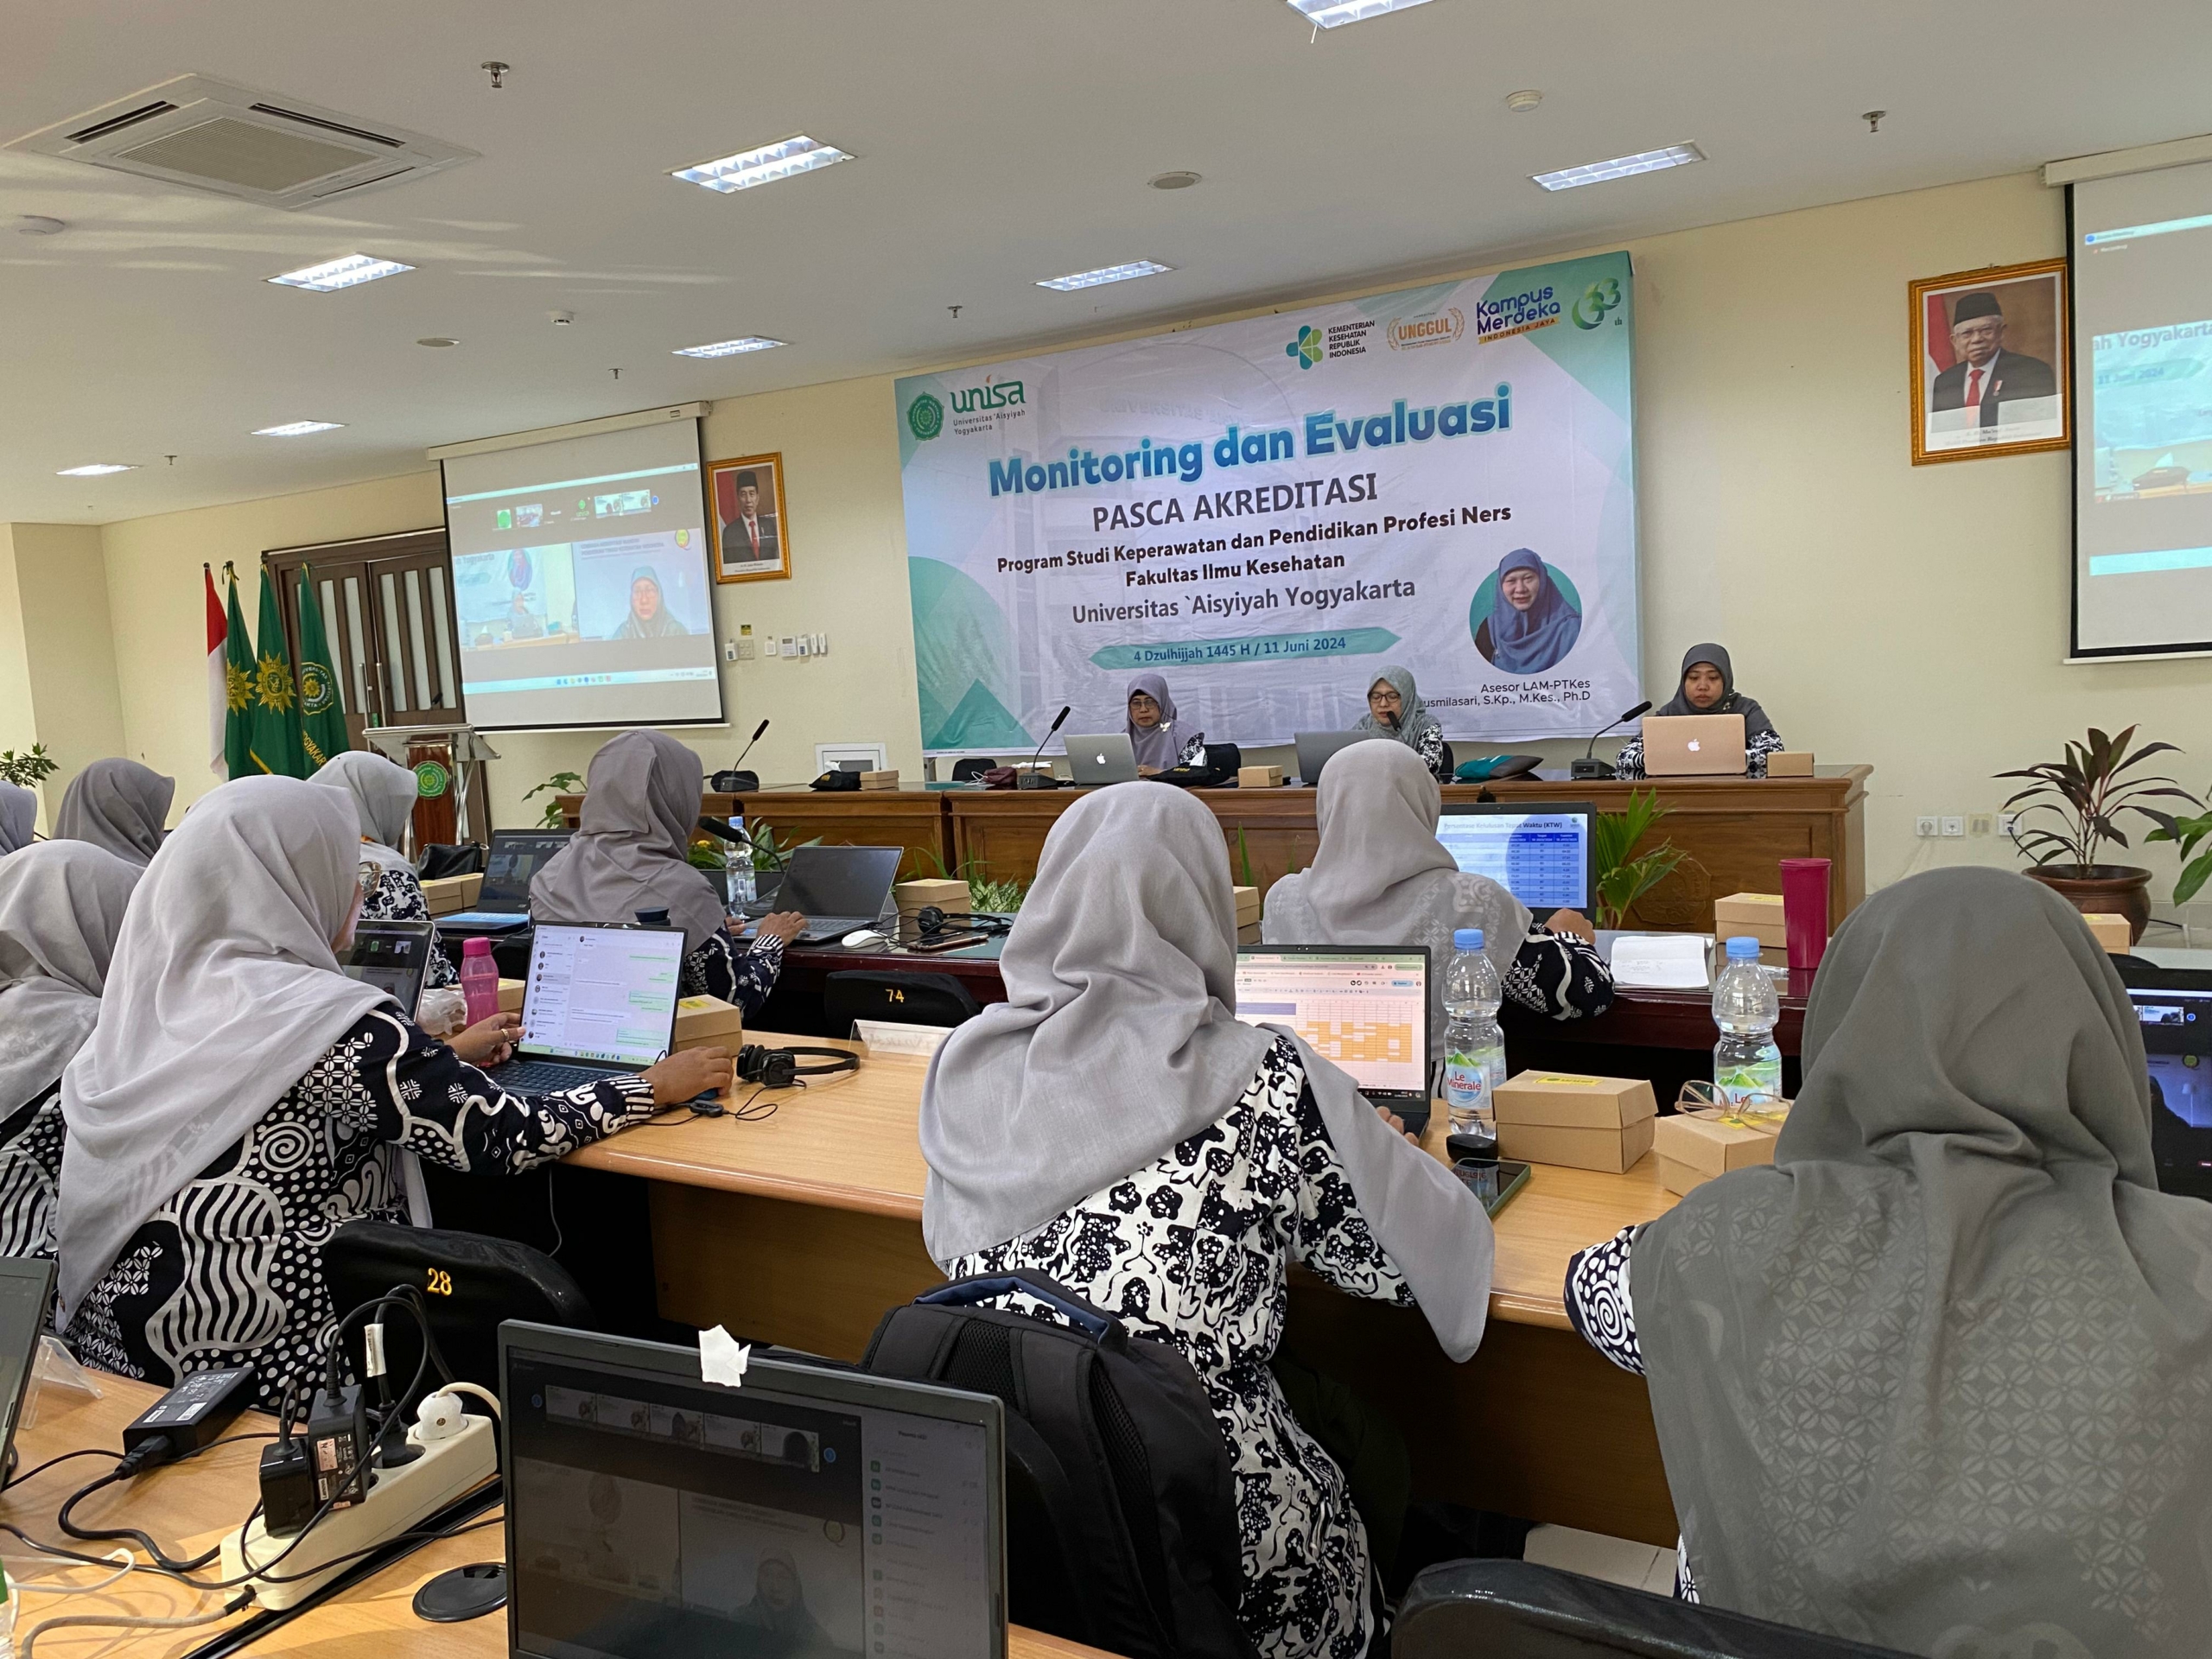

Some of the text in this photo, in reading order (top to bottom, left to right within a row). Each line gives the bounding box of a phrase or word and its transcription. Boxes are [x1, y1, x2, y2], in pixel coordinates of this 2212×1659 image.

[1477, 286, 1554, 319] Kampus
[1328, 321, 1375, 334] KEMENTERIAN
[1398, 318, 1452, 340] UNGGUL
[1477, 302, 1561, 335] Merdeka
[1484, 317, 1556, 342] INDONESIA JAYA
[1328, 330, 1367, 342] KESEHATAN
[1329, 339, 1361, 350] REPUBLIK
[1329, 346, 1367, 359] INDONESIA
[950, 374, 1027, 413] unisa
[953, 413, 993, 427] Universitas
[954, 424, 993, 435] Yogyakarta
[988, 384, 1510, 497] Monitoring dan Evaluasi
[1093, 473, 1378, 532] PASCA AKREDITASI
[997, 506, 1512, 574] Program Studi Keperawatan dan Pendidikan Profesi Ners
[1126, 554, 1345, 587] Fakultas Ilmu Kesehatan
[1072, 598, 1179, 624] Universitas
[1285, 578, 1415, 610] Yogyakarta
[1134, 637, 1346, 663] 4 Dzulhijjah 1445 H / 11 Juni 2024
[1480, 678, 1591, 694] Asesor LAM-PTKes
[1425, 690, 1591, 708] usmilasari, S.Kp., M.Kes., Ph.D
[302, 729, 328, 766] OGYAKAR
[1543, 821, 1563, 830] (KTW)
[886, 988, 905, 1003] 74
[1446, 1077, 1482, 1090] Minerale
[1454, 1071, 1465, 1082] Le
[427, 1268, 453, 1296] 28
